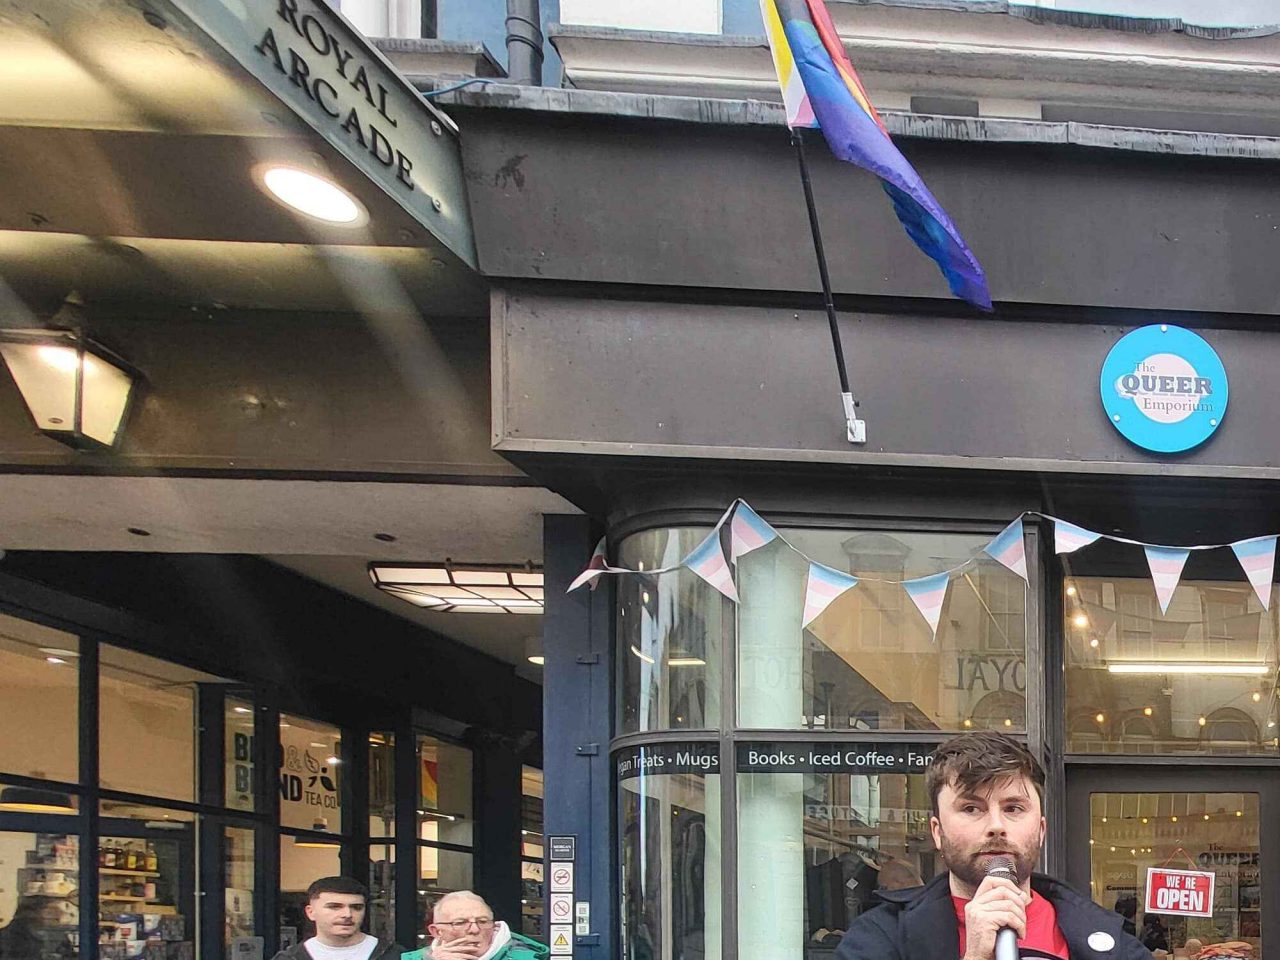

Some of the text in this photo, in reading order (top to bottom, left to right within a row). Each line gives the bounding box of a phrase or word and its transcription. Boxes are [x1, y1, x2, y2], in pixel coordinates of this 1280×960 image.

[276, 0, 398, 128] ROYAL
[254, 27, 415, 191] ARCADE
[1134, 362, 1156, 373] The
[1121, 374, 1213, 396] QUEER
[1143, 397, 1214, 415] Emporium
[676, 752, 719, 769] Mugs
[748, 751, 796, 766] Books
[808, 751, 841, 766] Iced
[845, 752, 895, 766] Coffee
[304, 790, 322, 806] TEA
[1165, 875, 1197, 890] WE'RE
[1157, 888, 1204, 912] OPEN
